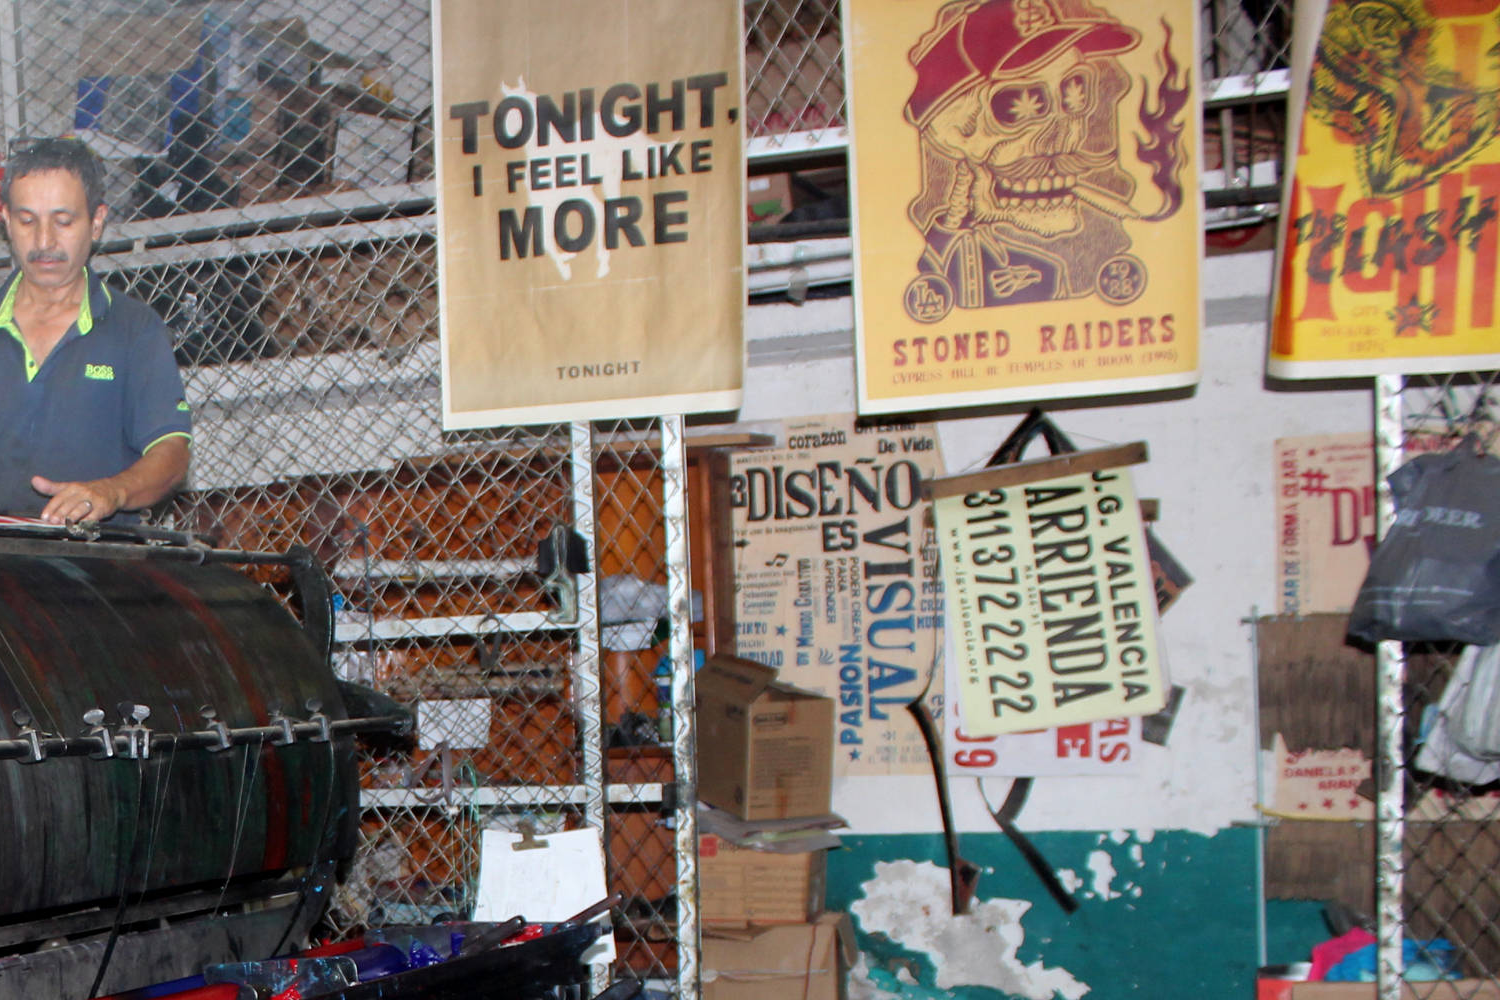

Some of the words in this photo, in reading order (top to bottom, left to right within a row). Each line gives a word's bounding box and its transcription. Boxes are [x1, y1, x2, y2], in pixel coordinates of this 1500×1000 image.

[450, 72, 738, 155] TONIGHT,
[473, 164, 484, 198] I
[507, 153, 603, 193] FEEL
[622, 140, 714, 180] LIKE
[498, 190, 690, 260] MORE
[85, 363, 115, 377] BOSS
[557, 360, 641, 380] TONIGHT
[892, 330, 1011, 368] STONED
[1040, 314, 1176, 354] RAIDERS
[788, 430, 847, 450] corazón
[878, 438, 896, 454] De
[902, 436, 934, 452] Vida
[746, 458, 922, 522] DISEÑO
[821, 520, 858, 552] ES
[824, 559, 837, 624] APRENDER
[836, 557, 848, 593] PARA
[850, 556, 861, 598] PODER
[1024, 486, 1114, 708] ARRIENDA
[863, 515, 918, 720] VISUAL
[1103, 535, 1151, 702] VALENCIA
[840, 644, 863, 745] PASION
